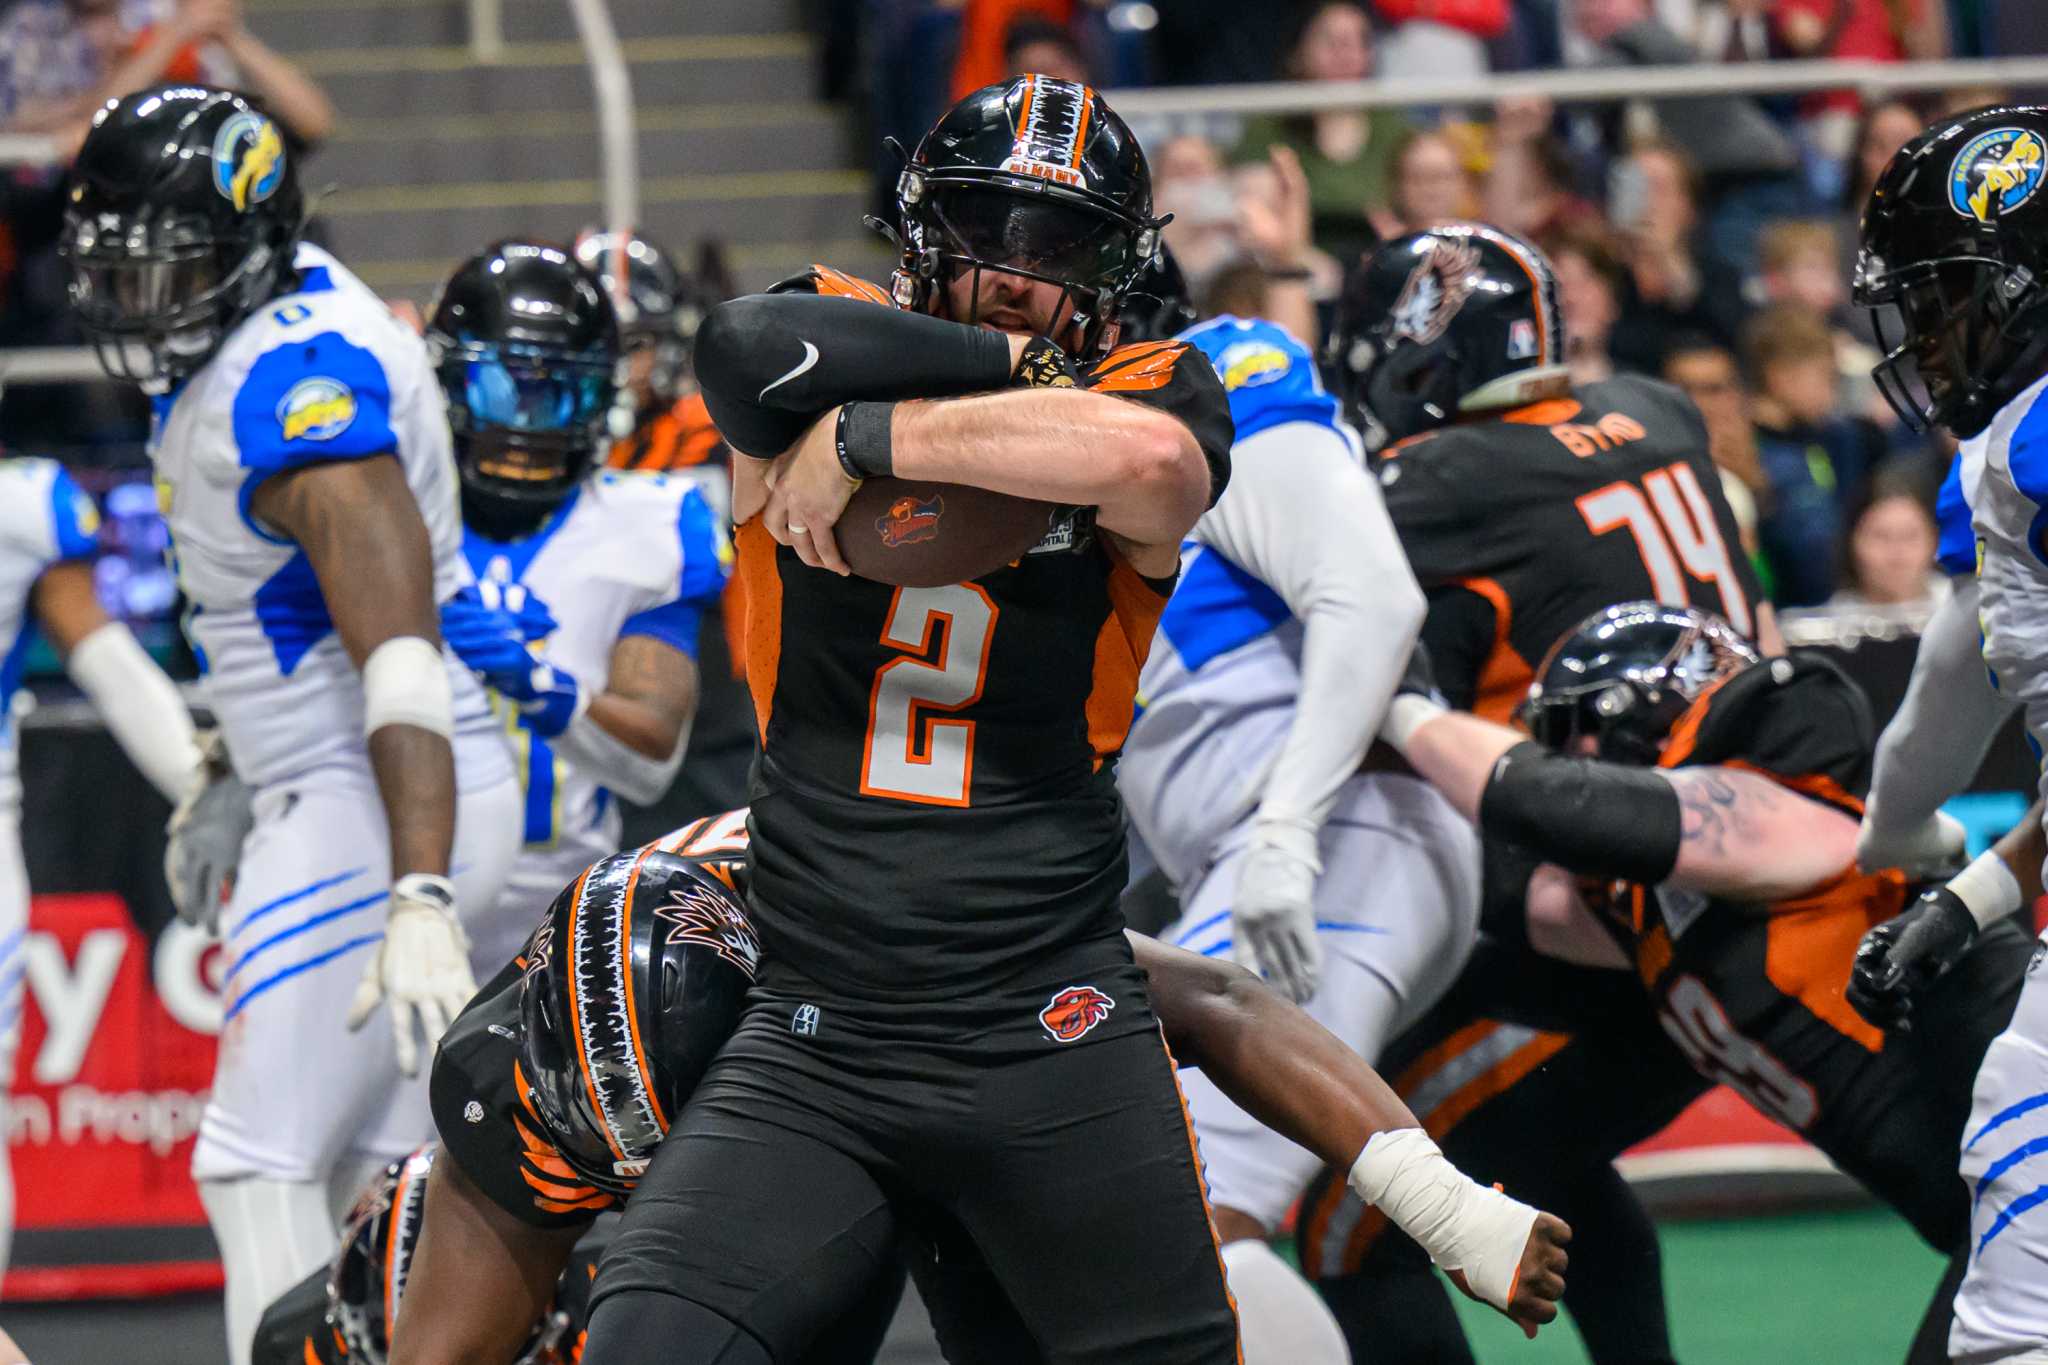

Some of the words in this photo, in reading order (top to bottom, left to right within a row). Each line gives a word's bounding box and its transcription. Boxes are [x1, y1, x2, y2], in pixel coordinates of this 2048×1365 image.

[273, 303, 313, 327] 0
[1573, 460, 1754, 641] 74
[859, 580, 1000, 809] 2
